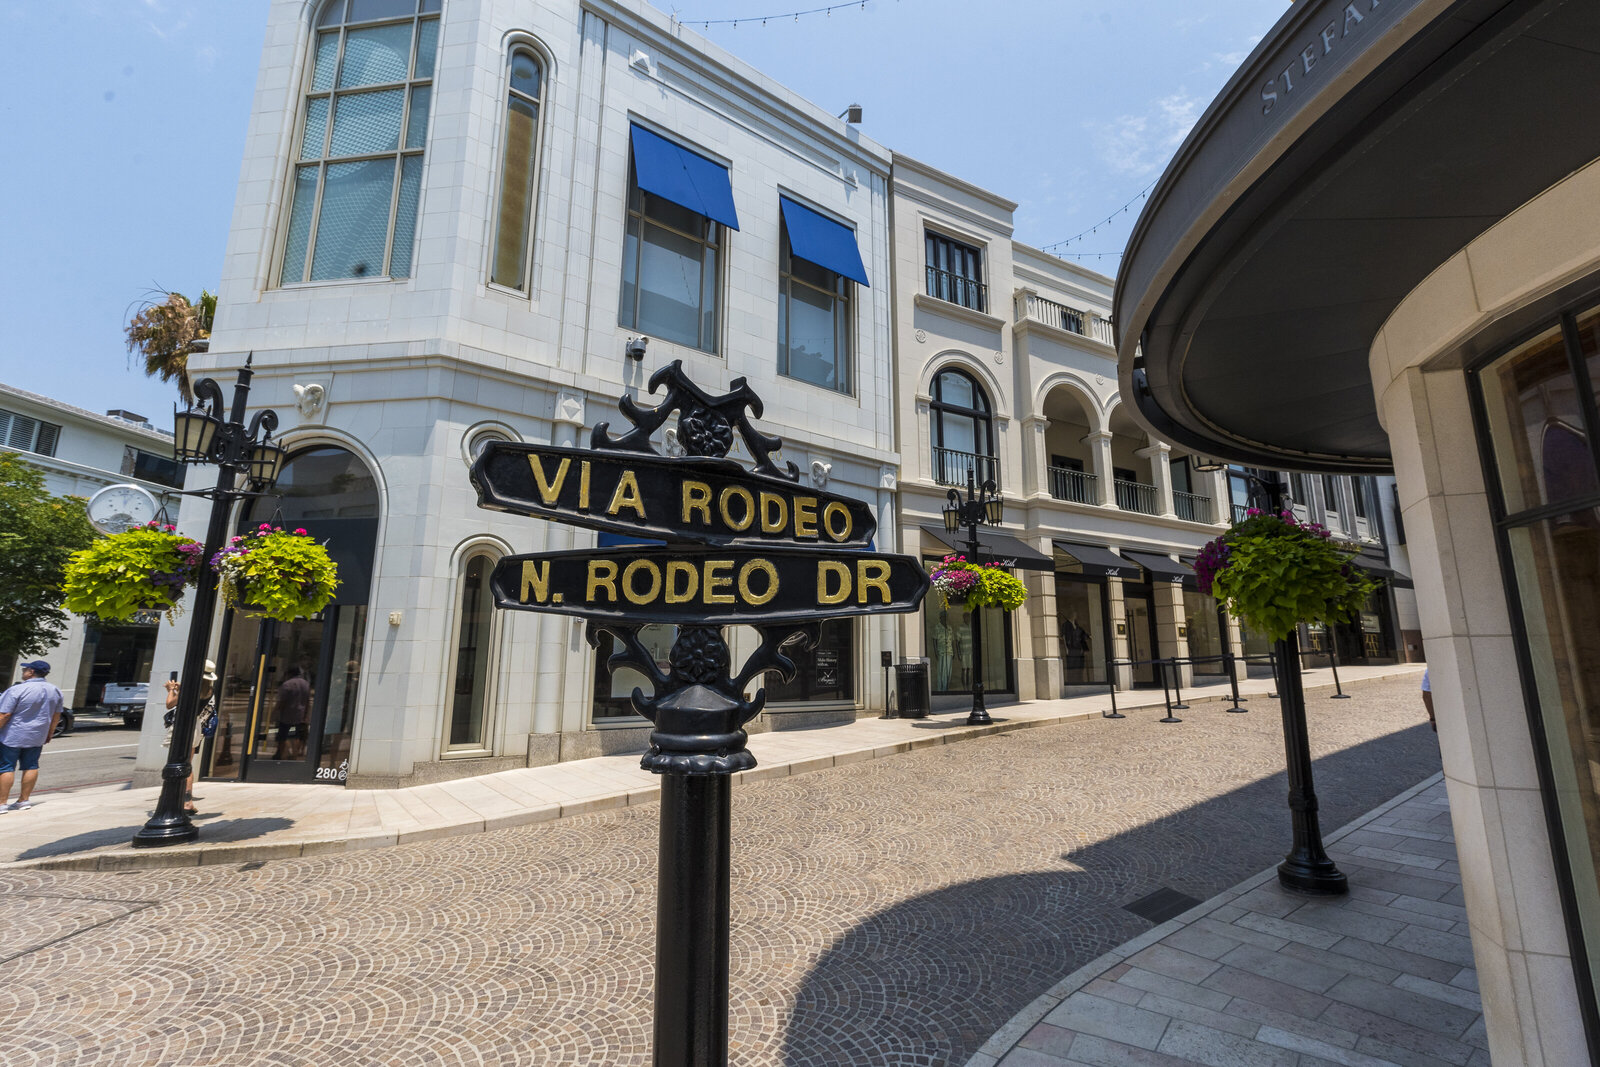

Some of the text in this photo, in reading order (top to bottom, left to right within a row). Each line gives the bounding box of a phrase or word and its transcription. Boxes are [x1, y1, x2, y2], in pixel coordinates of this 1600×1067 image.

[527, 453, 853, 543] VIA RODEO
[519, 558, 892, 606] N. RODEO DR
[316, 767, 337, 779] 280
